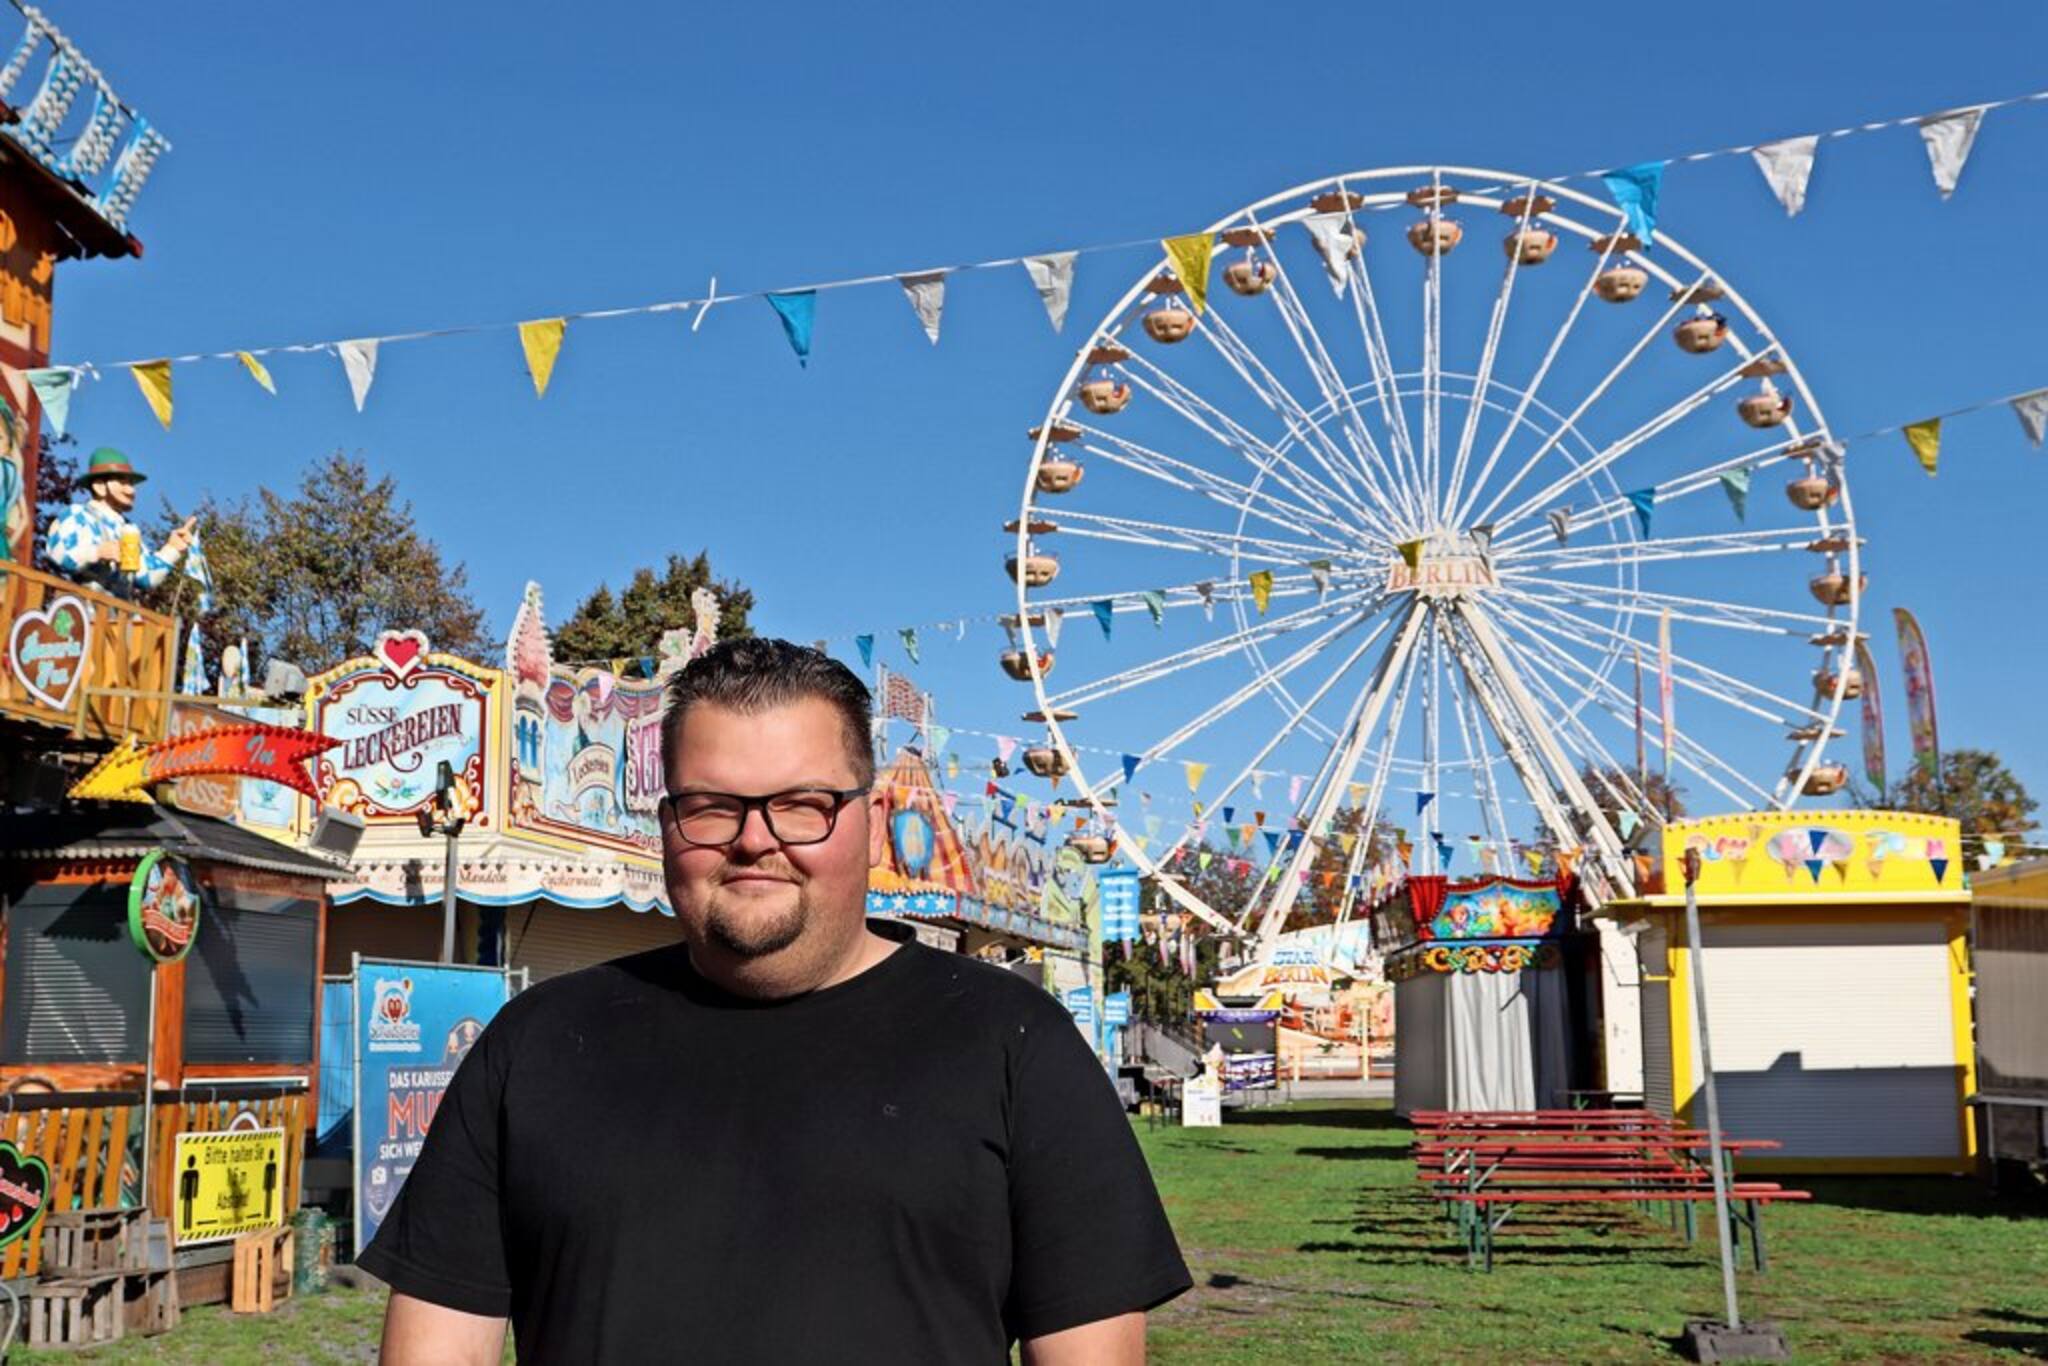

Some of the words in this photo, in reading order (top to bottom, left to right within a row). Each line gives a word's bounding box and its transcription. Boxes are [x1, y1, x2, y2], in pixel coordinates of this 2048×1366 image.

[346, 704, 400, 725] SÜSSE
[342, 703, 463, 773] LECKEREIEN
[389, 1072, 409, 1088] DAS
[411, 1070, 455, 1087] KARUSSE
[380, 1144, 403, 1159] SICH
